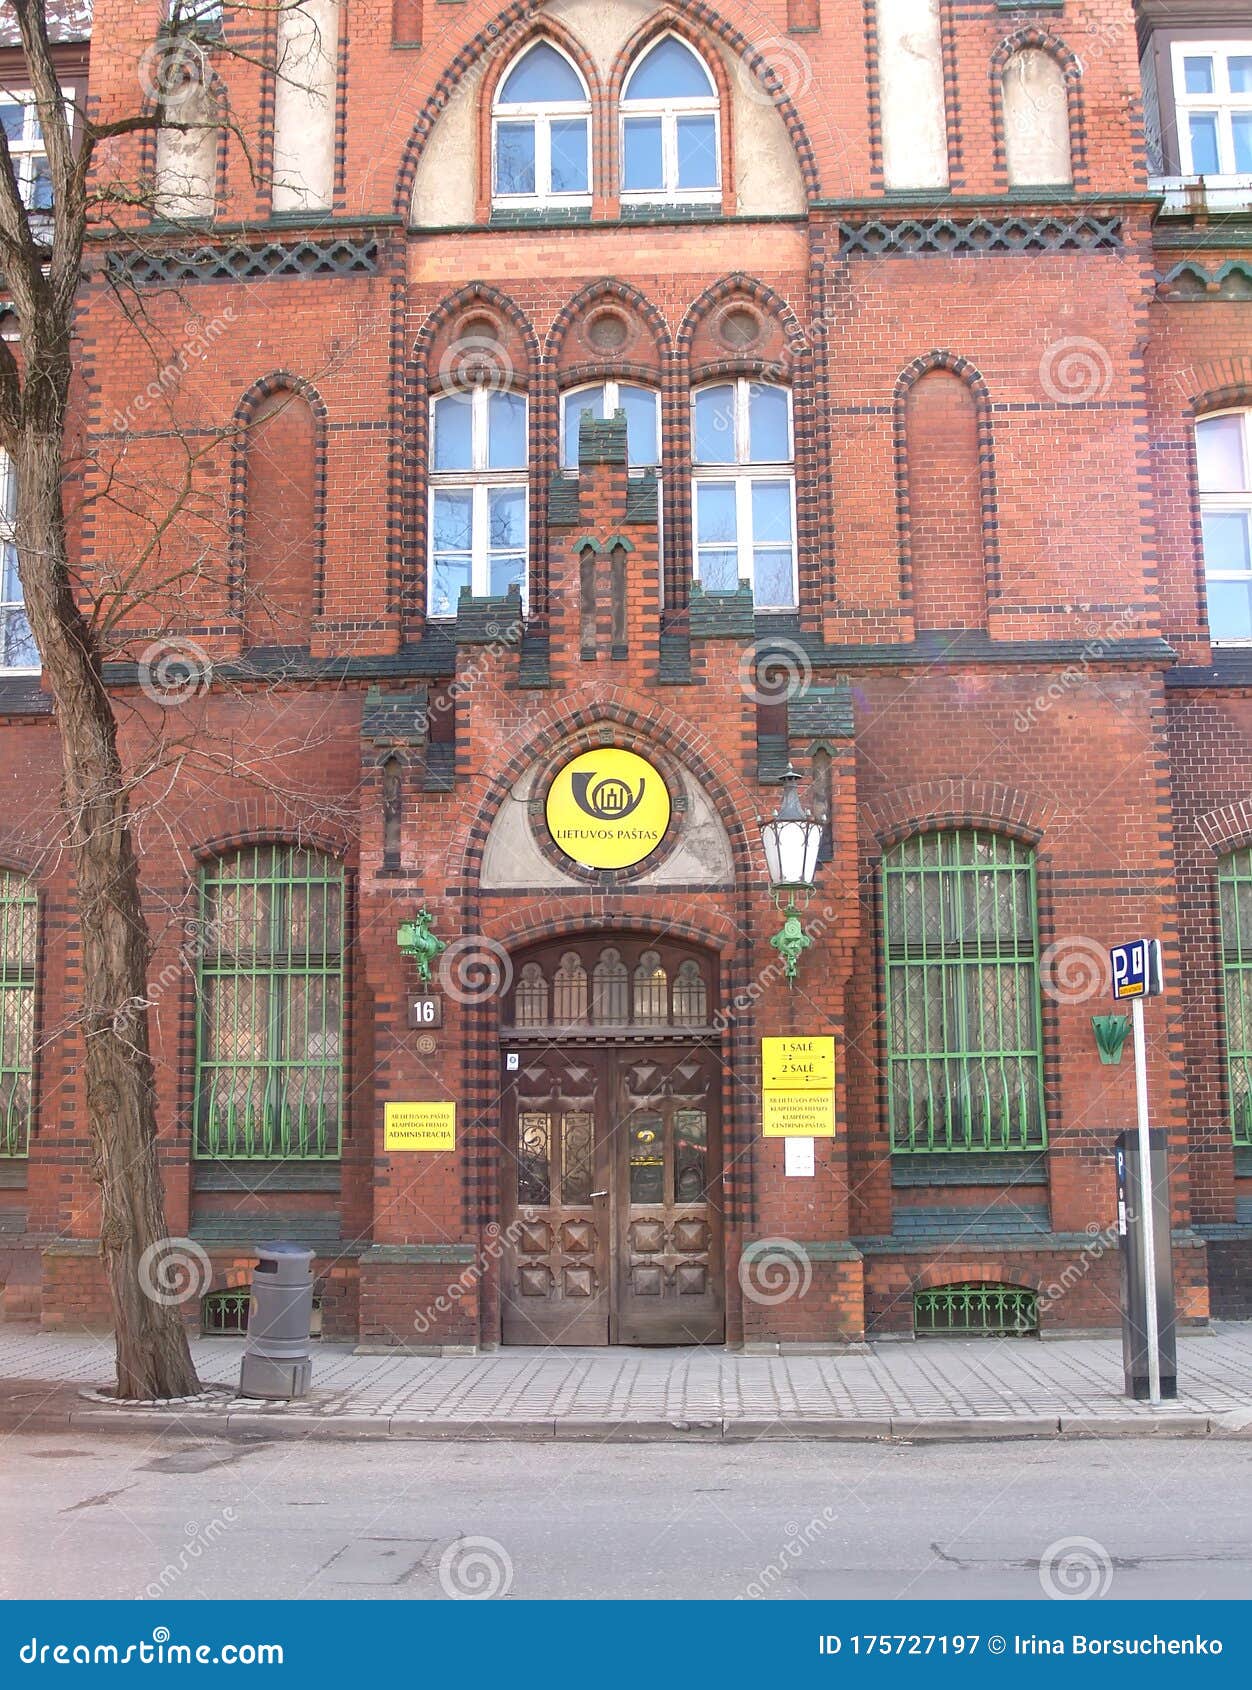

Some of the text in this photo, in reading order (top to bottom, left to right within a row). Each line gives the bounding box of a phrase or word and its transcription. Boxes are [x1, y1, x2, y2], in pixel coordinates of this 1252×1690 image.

[557, 828, 658, 840] LIETUVOS PAŠTAS
[1112, 948, 1128, 998] P
[414, 1001, 435, 1022] 16
[782, 1064, 788, 1072] 2
